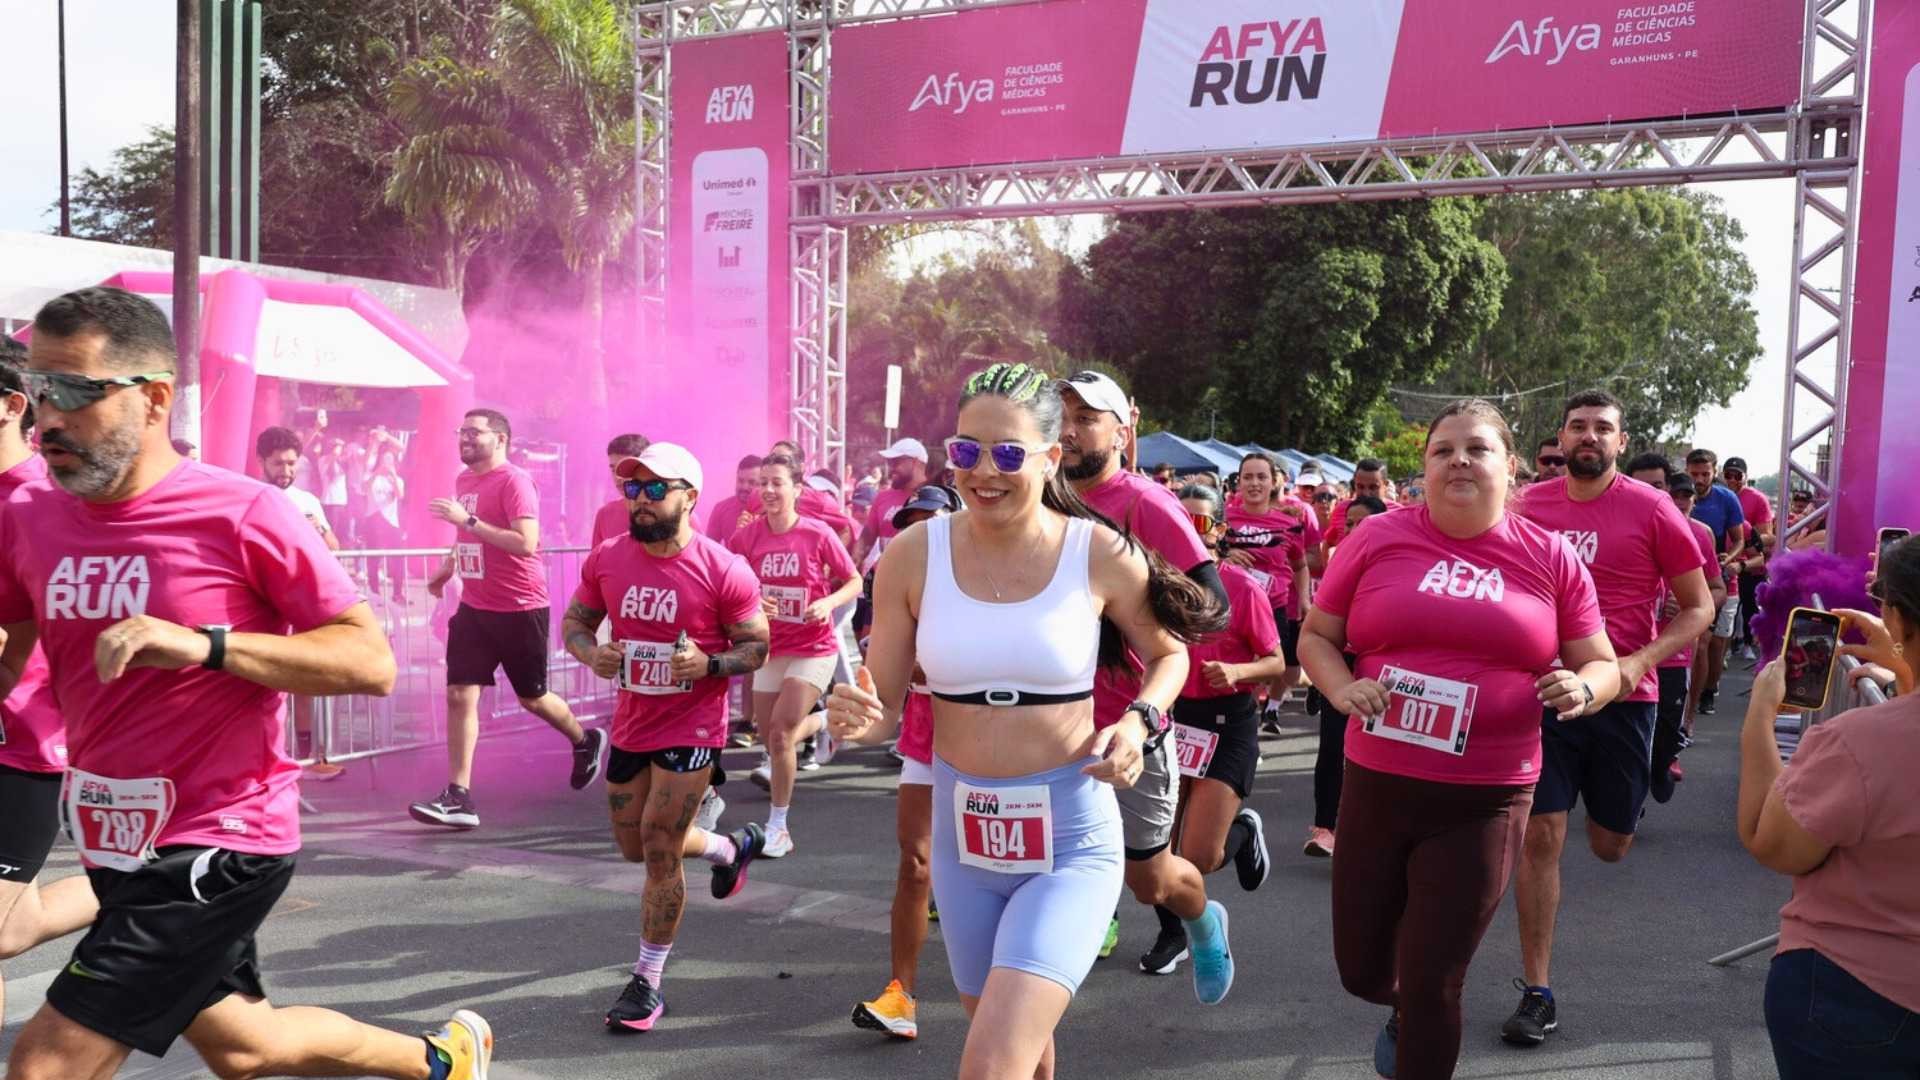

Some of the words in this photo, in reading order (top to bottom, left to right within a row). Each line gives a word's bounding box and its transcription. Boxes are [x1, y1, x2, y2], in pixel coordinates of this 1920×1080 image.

[1617, 1, 1696, 19] FACULDADE
[1615, 22, 1632, 33] DE
[1636, 14, 1696, 32] CIÊNCIAS
[1200, 17, 1327, 61] AFYA
[1485, 16, 1600, 65] Afya
[1612, 31, 1672, 48] MÉDICAS
[1610, 52, 1674, 66] GARANHUNS
[1685, 49, 1698, 58] PE
[1005, 62, 1062, 77] FACULDADE
[1003, 78, 1017, 88] DE
[1019, 73, 1064, 87] CIÊNCIAS
[1189, 53, 1327, 107] RUN
[711, 84, 754, 102] AFYA
[908, 72, 994, 114] Afya
[1001, 87, 1046, 100] MÉDICAS
[705, 101, 754, 124] RUN
[703, 178, 744, 191] Unimed
[715, 218, 753, 231] FREIRE
[762, 553, 799, 565] AFYA
[48, 555, 150, 584] AFYA
[761, 564, 799, 577] RUN
[1428, 560, 1504, 582] AFYA
[624, 585, 678, 606] AFYA
[1417, 572, 1505, 602] RUN
[46, 583, 150, 619] RUN
[620, 600, 678, 623] RUN
[634, 650, 656, 659] RUN
[640, 661, 671, 686] 240
[1401, 675, 1425, 688] AFYA
[1395, 682, 1425, 697] RUN
[1400, 699, 1440, 734] 017
[80, 790, 113, 805] RUN
[968, 792, 999, 804] AFYA
[967, 800, 999, 815] RUN
[91, 810, 146, 853] 288
[977, 819, 1026, 858] 194
